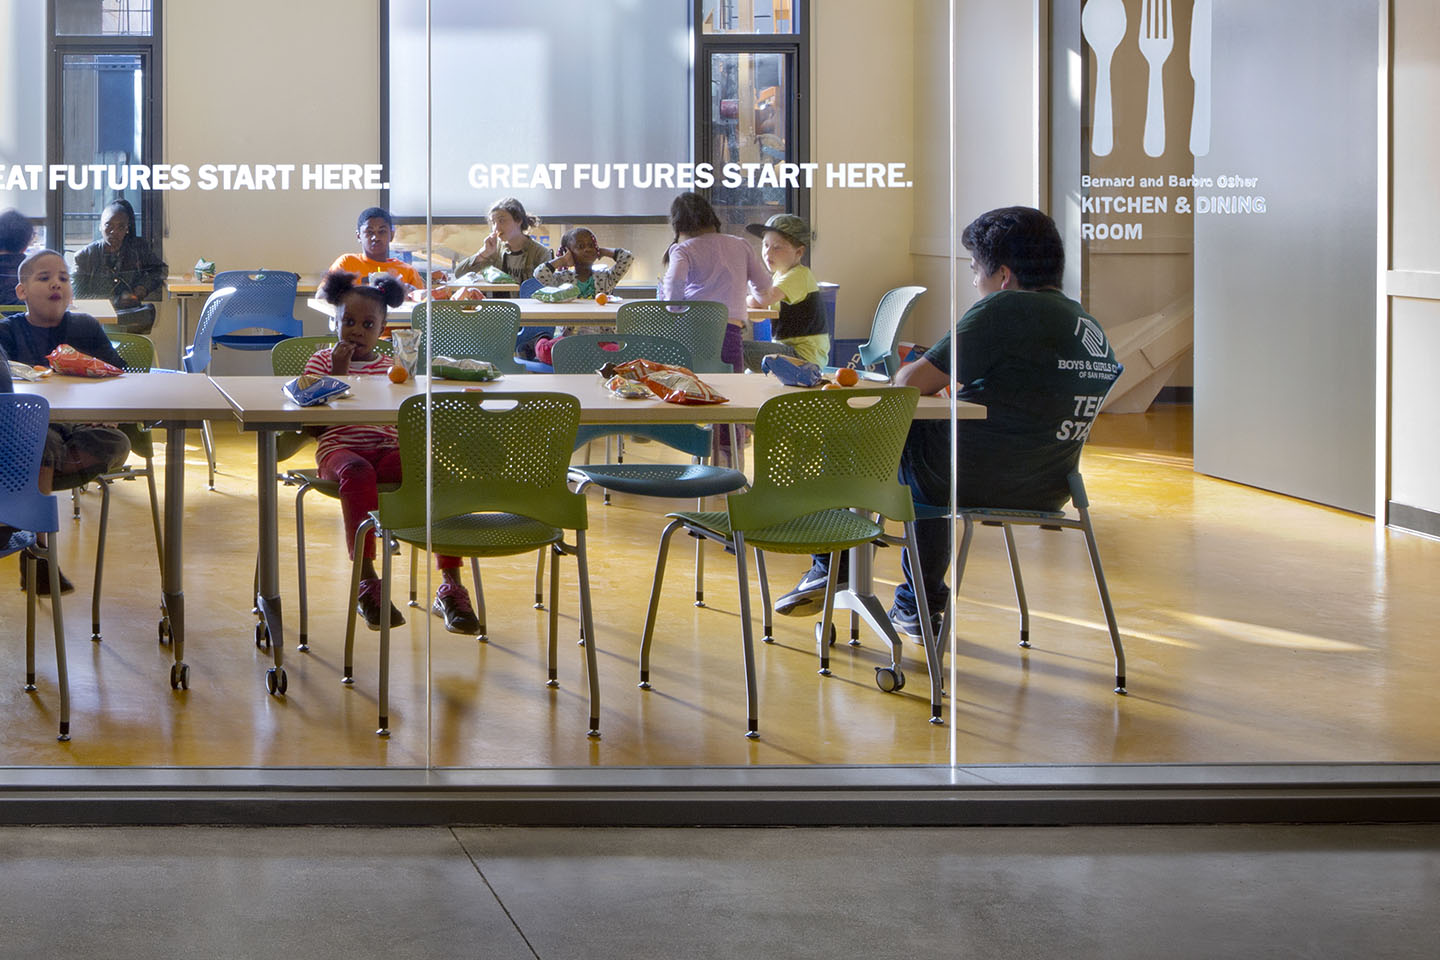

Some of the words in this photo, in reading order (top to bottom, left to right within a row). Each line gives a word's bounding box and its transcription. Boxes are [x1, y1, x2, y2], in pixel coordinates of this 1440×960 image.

[49, 164, 191, 191] FUTURES
[197, 164, 295, 191] START
[302, 164, 390, 191] HERE.
[469, 162, 567, 189] GREAT
[574, 162, 715, 189] FUTURES
[722, 162, 819, 189] START
[826, 162, 913, 189] HERE.
[1081, 175, 1135, 188] Bernard
[1139, 175, 1164, 188] and
[1081, 196, 1168, 214] KITCHEN
[1174, 196, 1192, 214] &
[1196, 196, 1267, 214] DINING
[1081, 223, 1143, 240] ROOM
[1057, 359, 1085, 370] BOYS
[1085, 360, 1092, 370] &
[1092, 361, 1112, 372] GIRLS
